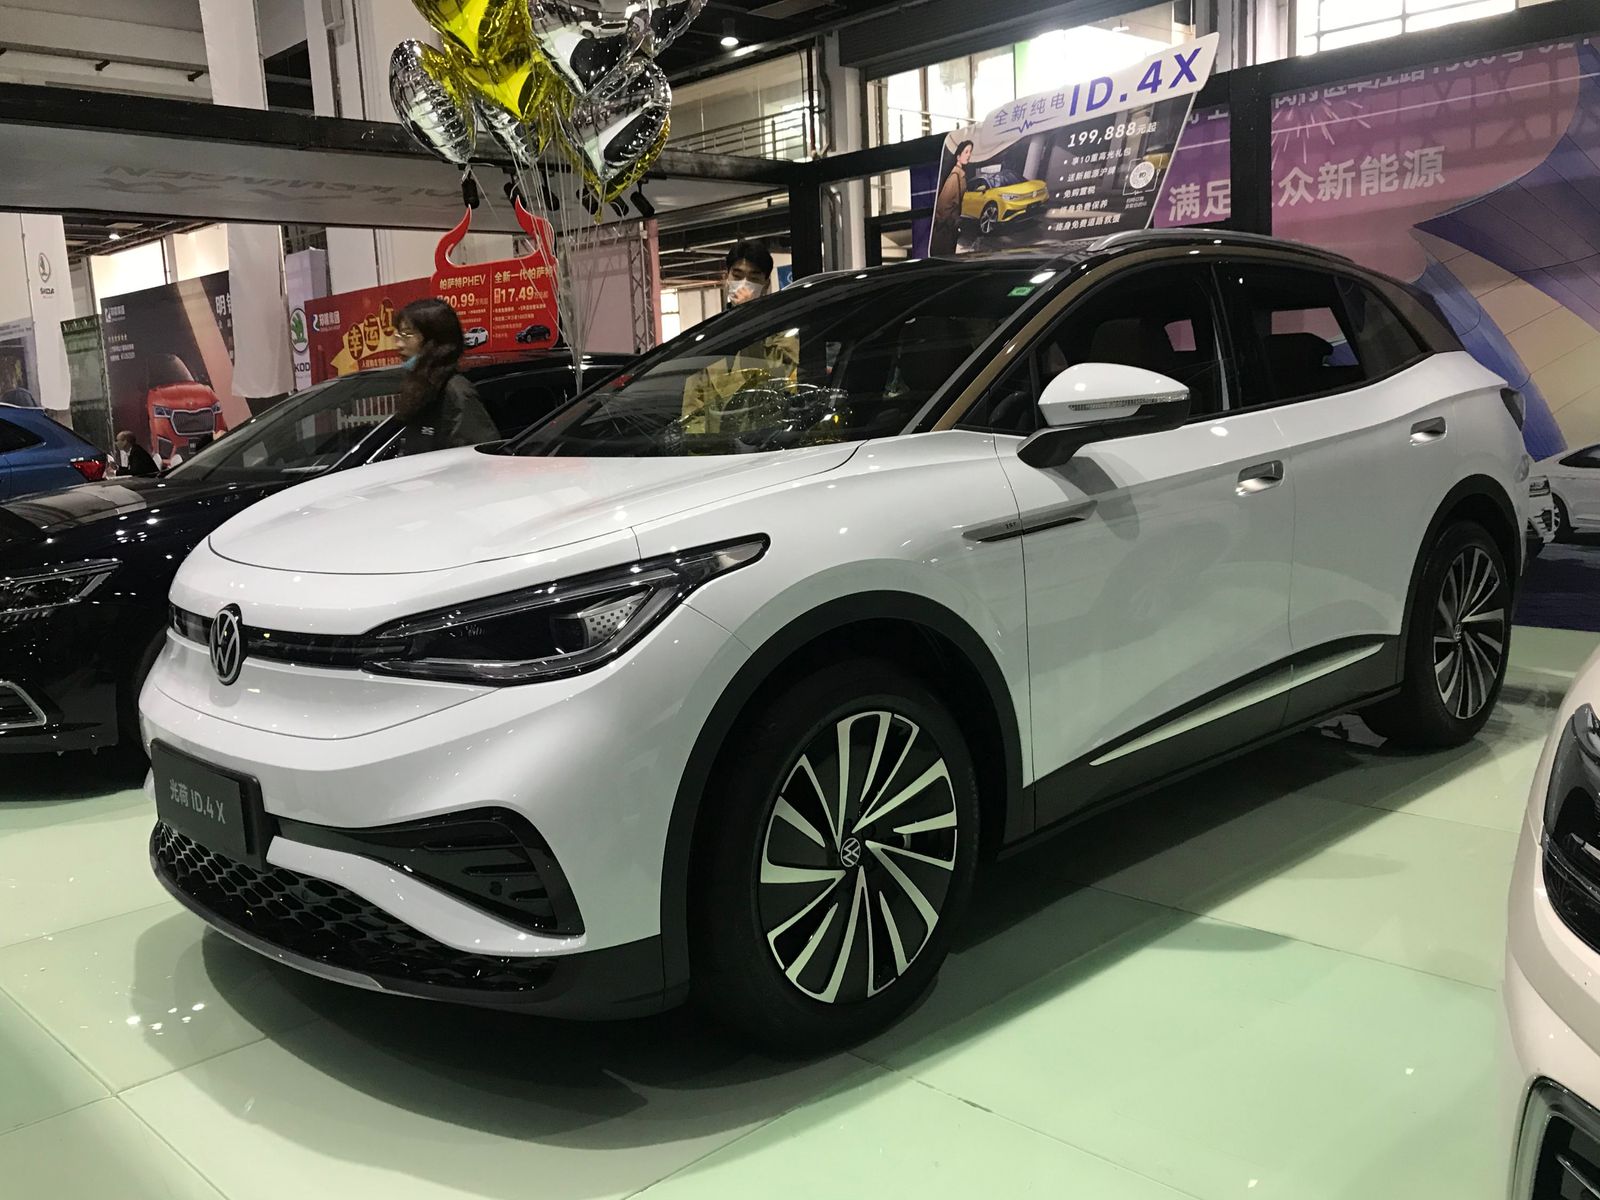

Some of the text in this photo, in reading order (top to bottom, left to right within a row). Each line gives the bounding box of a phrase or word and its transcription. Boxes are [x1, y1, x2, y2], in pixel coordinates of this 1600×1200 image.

[993, 92, 1065, 128] 全新纯电
[1067, 120, 1158, 148] 199,888元起
[494, 265, 553, 285] 全新一代帕萨特
